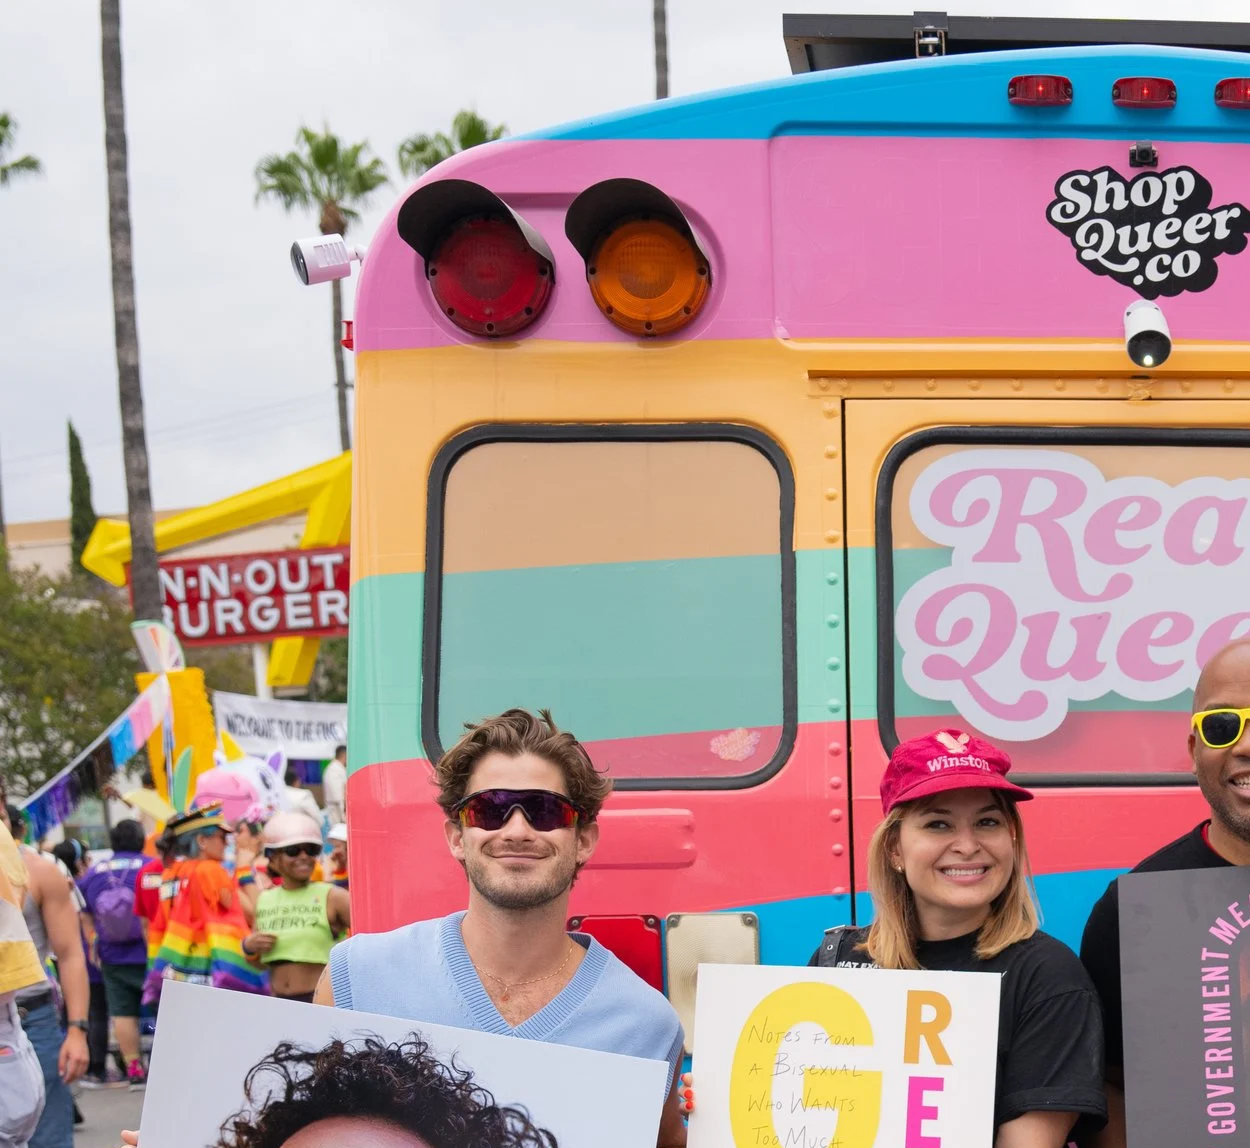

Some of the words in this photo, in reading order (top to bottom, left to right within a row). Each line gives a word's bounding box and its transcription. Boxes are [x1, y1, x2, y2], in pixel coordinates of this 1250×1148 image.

[1050, 170, 1195, 223] Shop
[1075, 207, 1241, 272] Queer
[1133, 250, 1201, 285] .co
[927, 755, 991, 772] Winston
[1201, 947, 1237, 1136] GOVERNMENT
[748, 1063, 763, 1075] A
